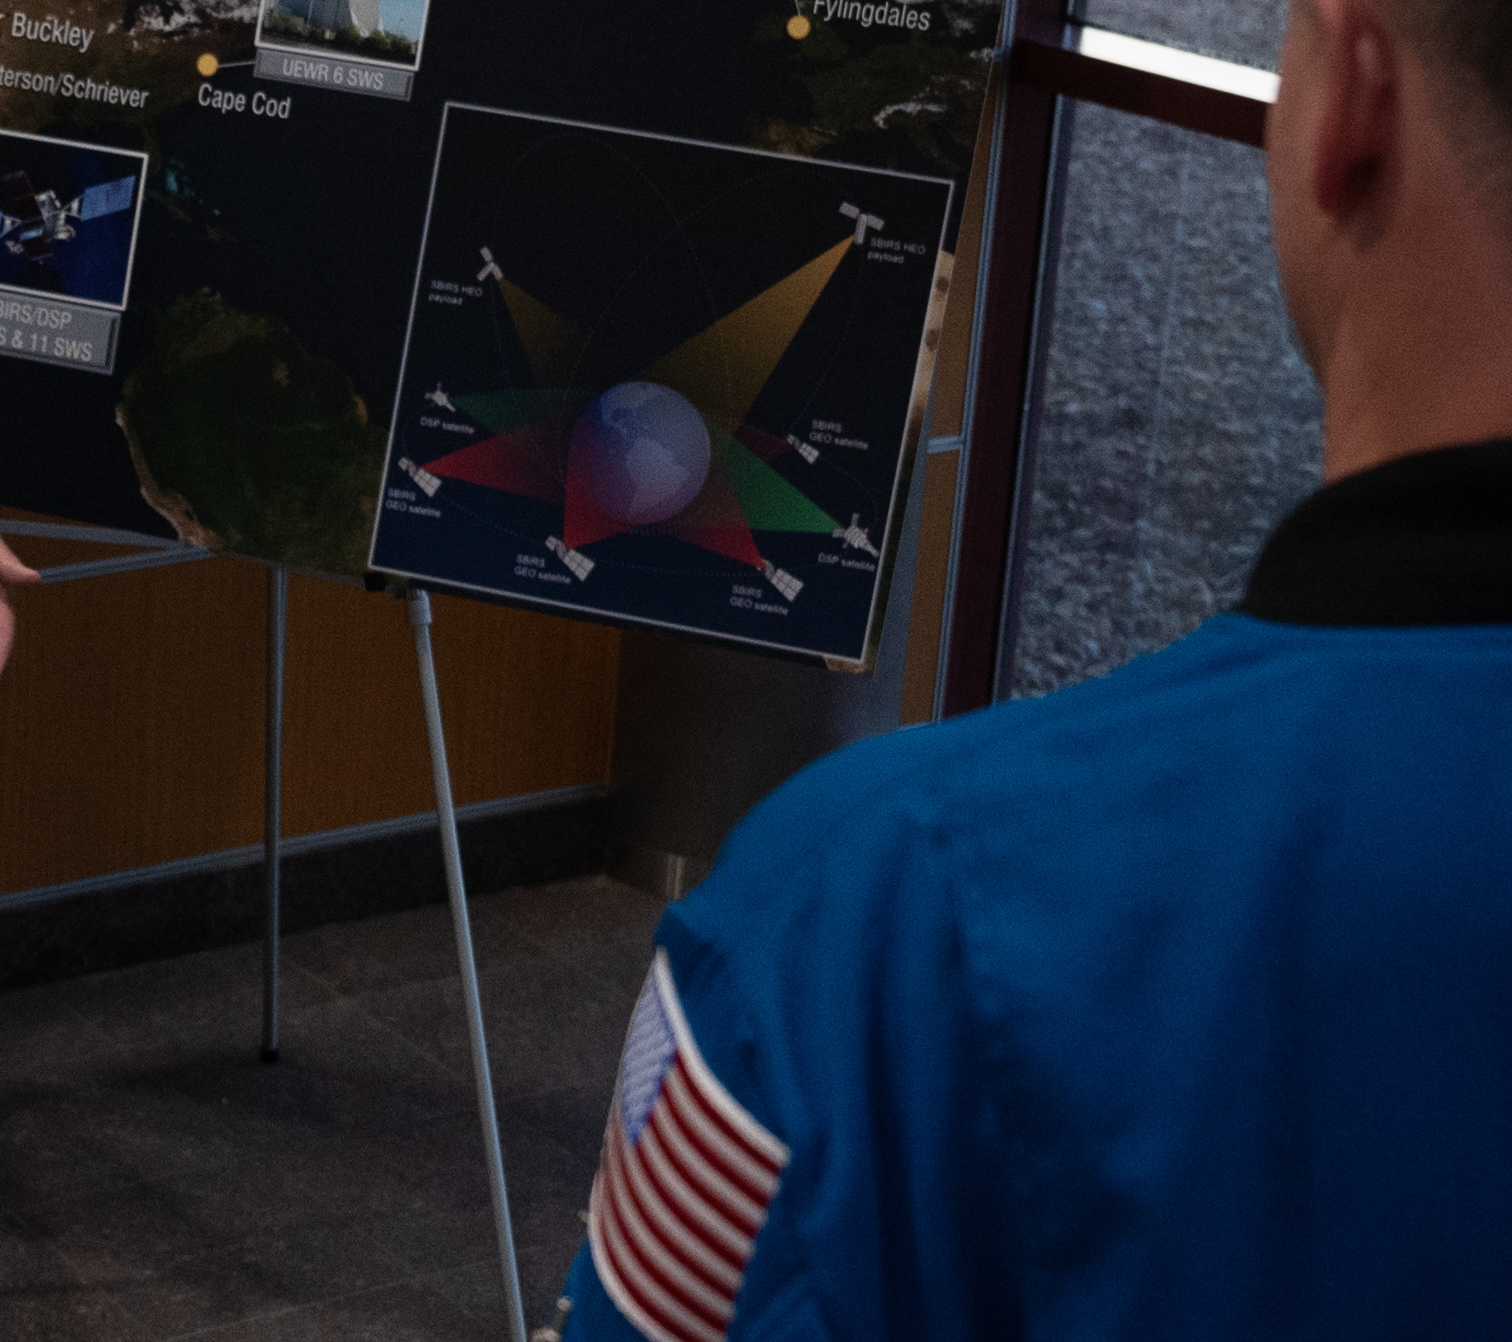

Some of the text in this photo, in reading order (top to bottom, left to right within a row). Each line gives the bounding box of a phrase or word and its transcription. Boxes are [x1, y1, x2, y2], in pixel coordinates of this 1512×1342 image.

[11, 12, 93, 53] Buckley
[283, 59, 384, 91] UEWR 6 SWS
[197, 82, 291, 119] Cape Cod
[11, 330, 23, 349] &
[30, 333, 48, 353] 11
[53, 337, 93, 362] SWS
